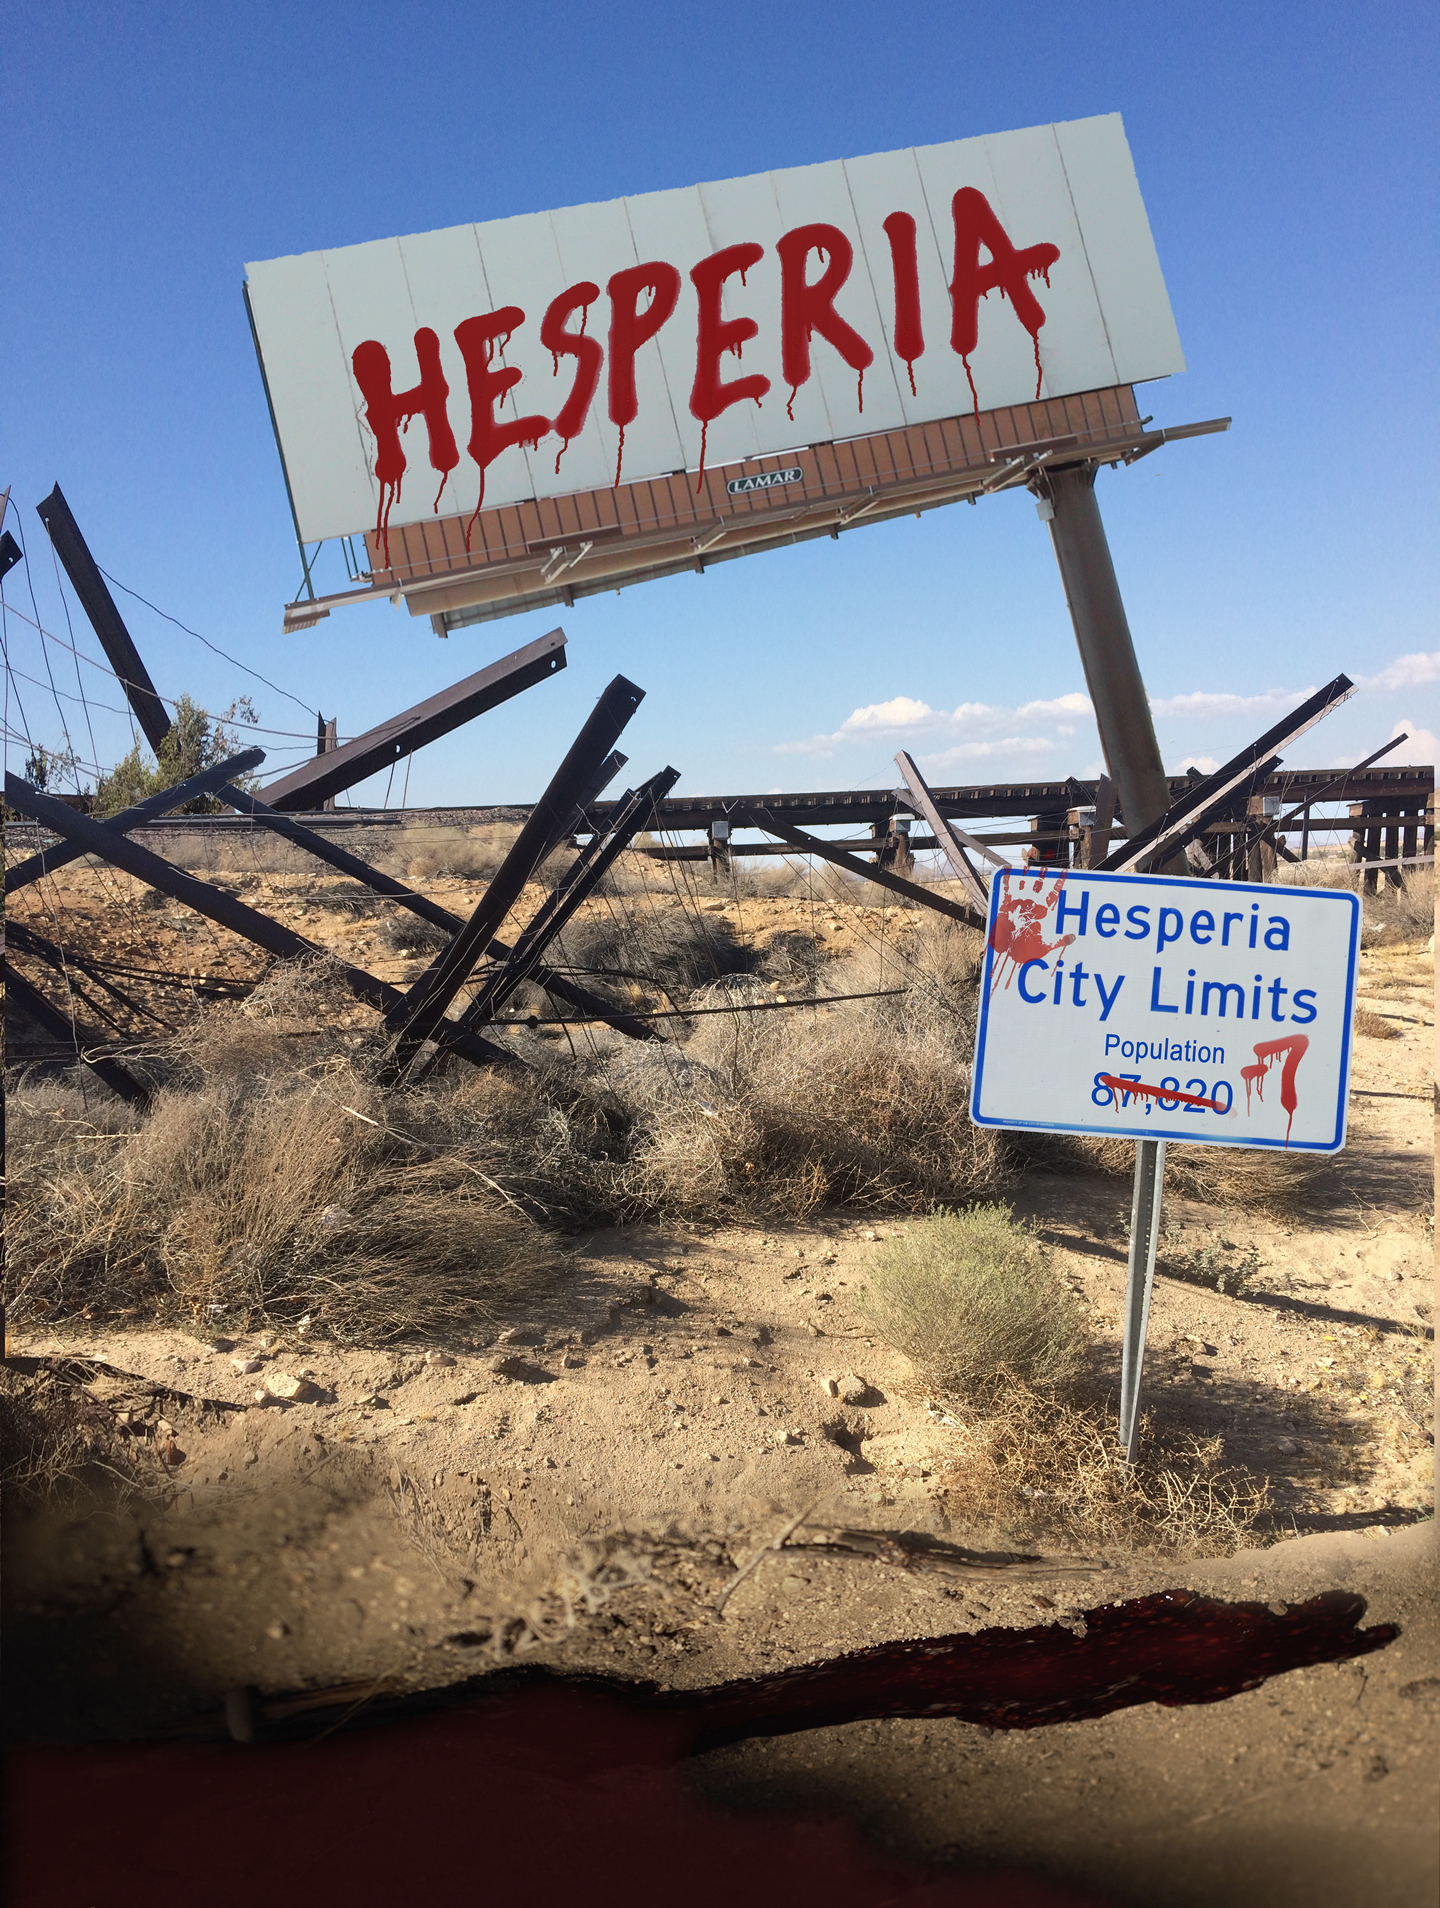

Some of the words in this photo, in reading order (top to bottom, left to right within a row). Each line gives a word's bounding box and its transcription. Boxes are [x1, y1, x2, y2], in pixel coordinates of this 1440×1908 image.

[352, 187, 1060, 569] HESPERIA
[734, 470, 795, 492] LAMAR
[1055, 889, 1291, 954] Hesperia
[1017, 959, 1125, 1021] City
[1151, 967, 1317, 1024] Limits
[1105, 1034, 1224, 1064] Population
[1092, 1072, 1233, 1115] 87,820
